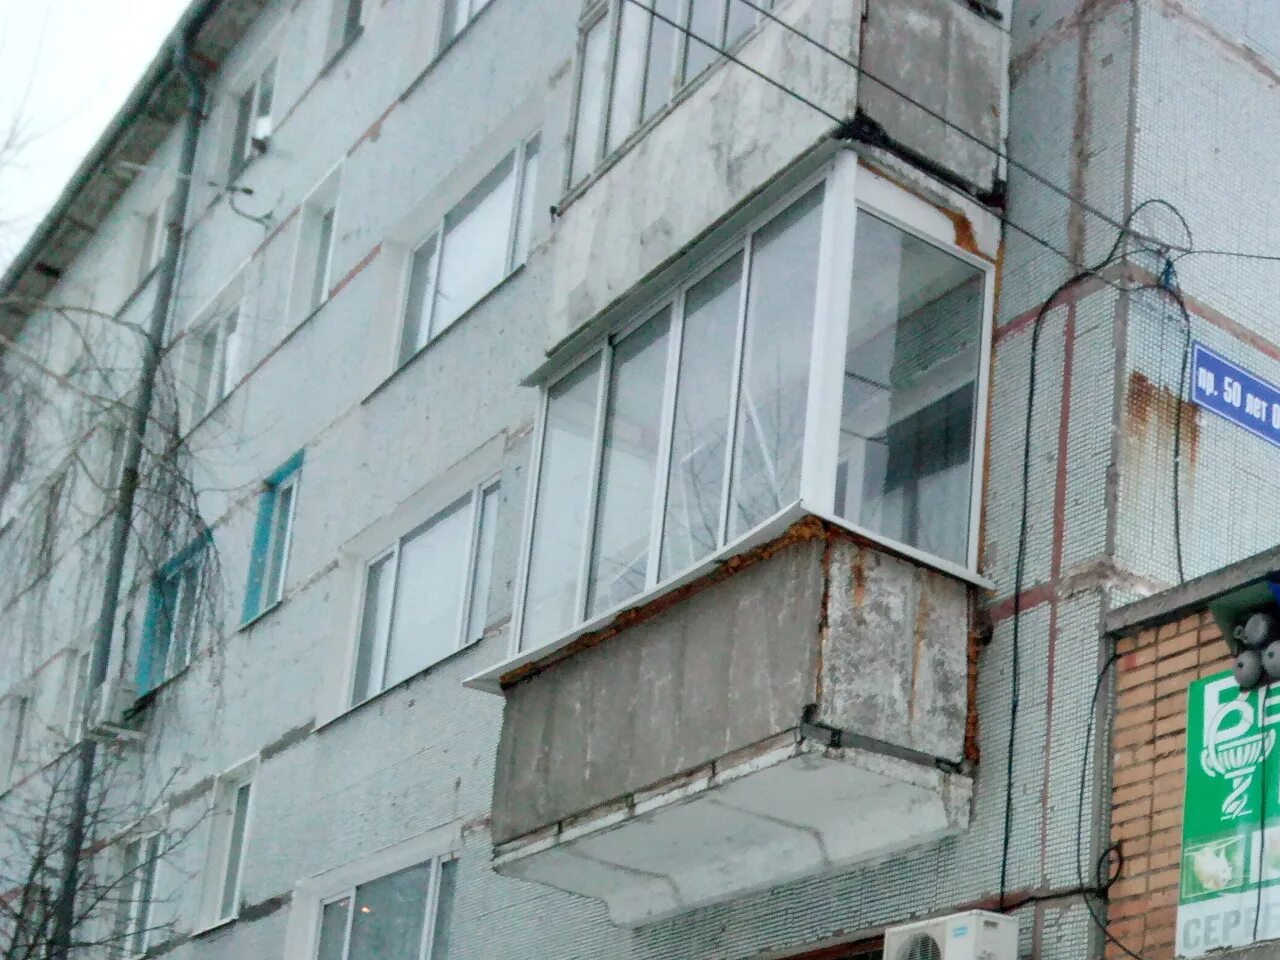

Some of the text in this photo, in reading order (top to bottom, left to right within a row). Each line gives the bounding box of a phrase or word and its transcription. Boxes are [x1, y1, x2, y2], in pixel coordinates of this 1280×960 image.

[1198, 366, 1219, 396] пр.
[1223, 376, 1242, 408] 50
[1245, 393, 1268, 422] лет
